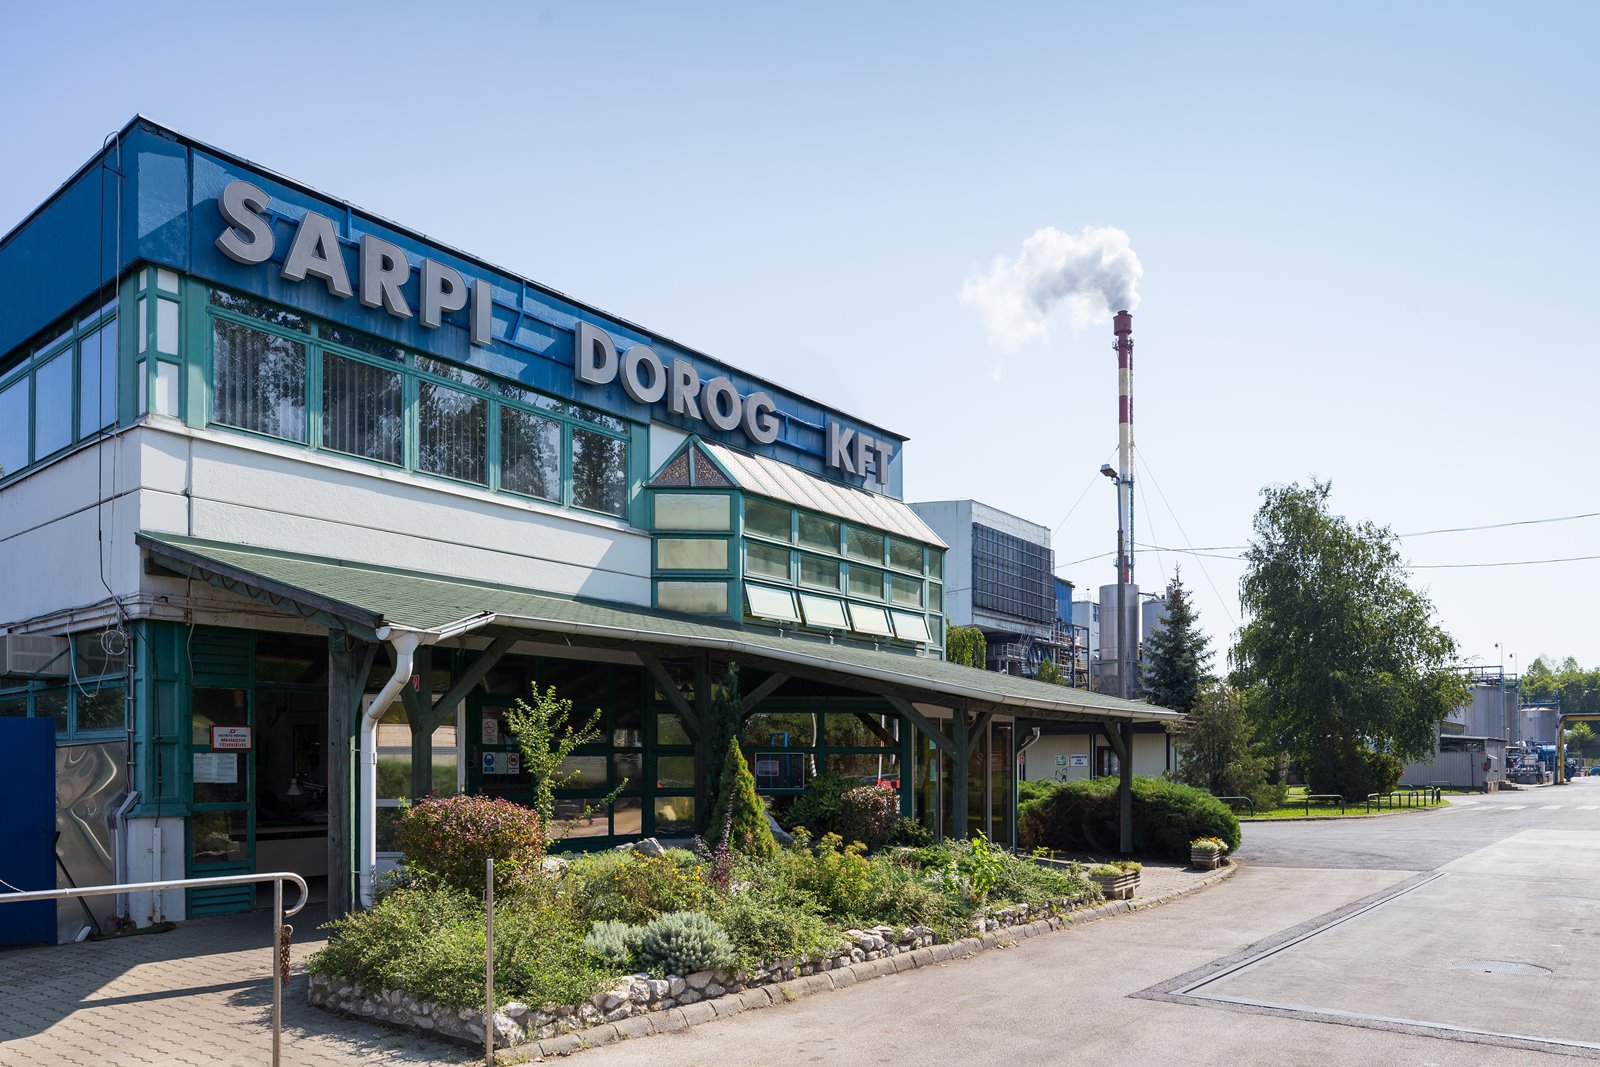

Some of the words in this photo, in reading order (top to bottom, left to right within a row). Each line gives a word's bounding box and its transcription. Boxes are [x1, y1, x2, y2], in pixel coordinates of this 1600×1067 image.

[214, 179, 493, 346] SARPI
[574, 320, 780, 444] DOROG
[825, 421, 894, 486] KFT
